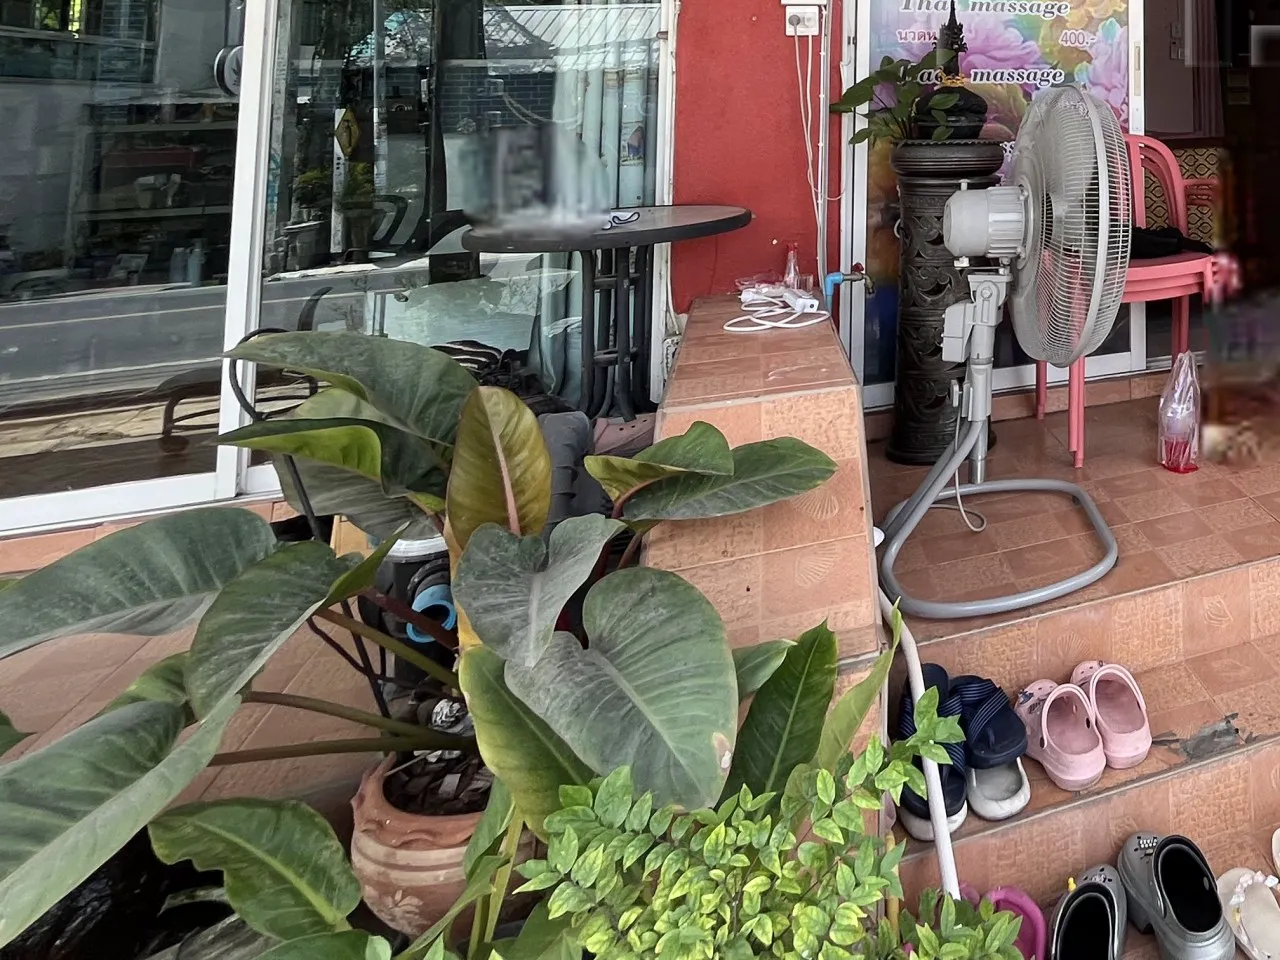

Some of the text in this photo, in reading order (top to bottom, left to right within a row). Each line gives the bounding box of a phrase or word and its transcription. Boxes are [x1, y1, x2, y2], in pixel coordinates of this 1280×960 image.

[971, 0, 1070, 19] massage
[1061, 31, 1096, 46] 400.-
[972, 68, 1064, 87] massage
